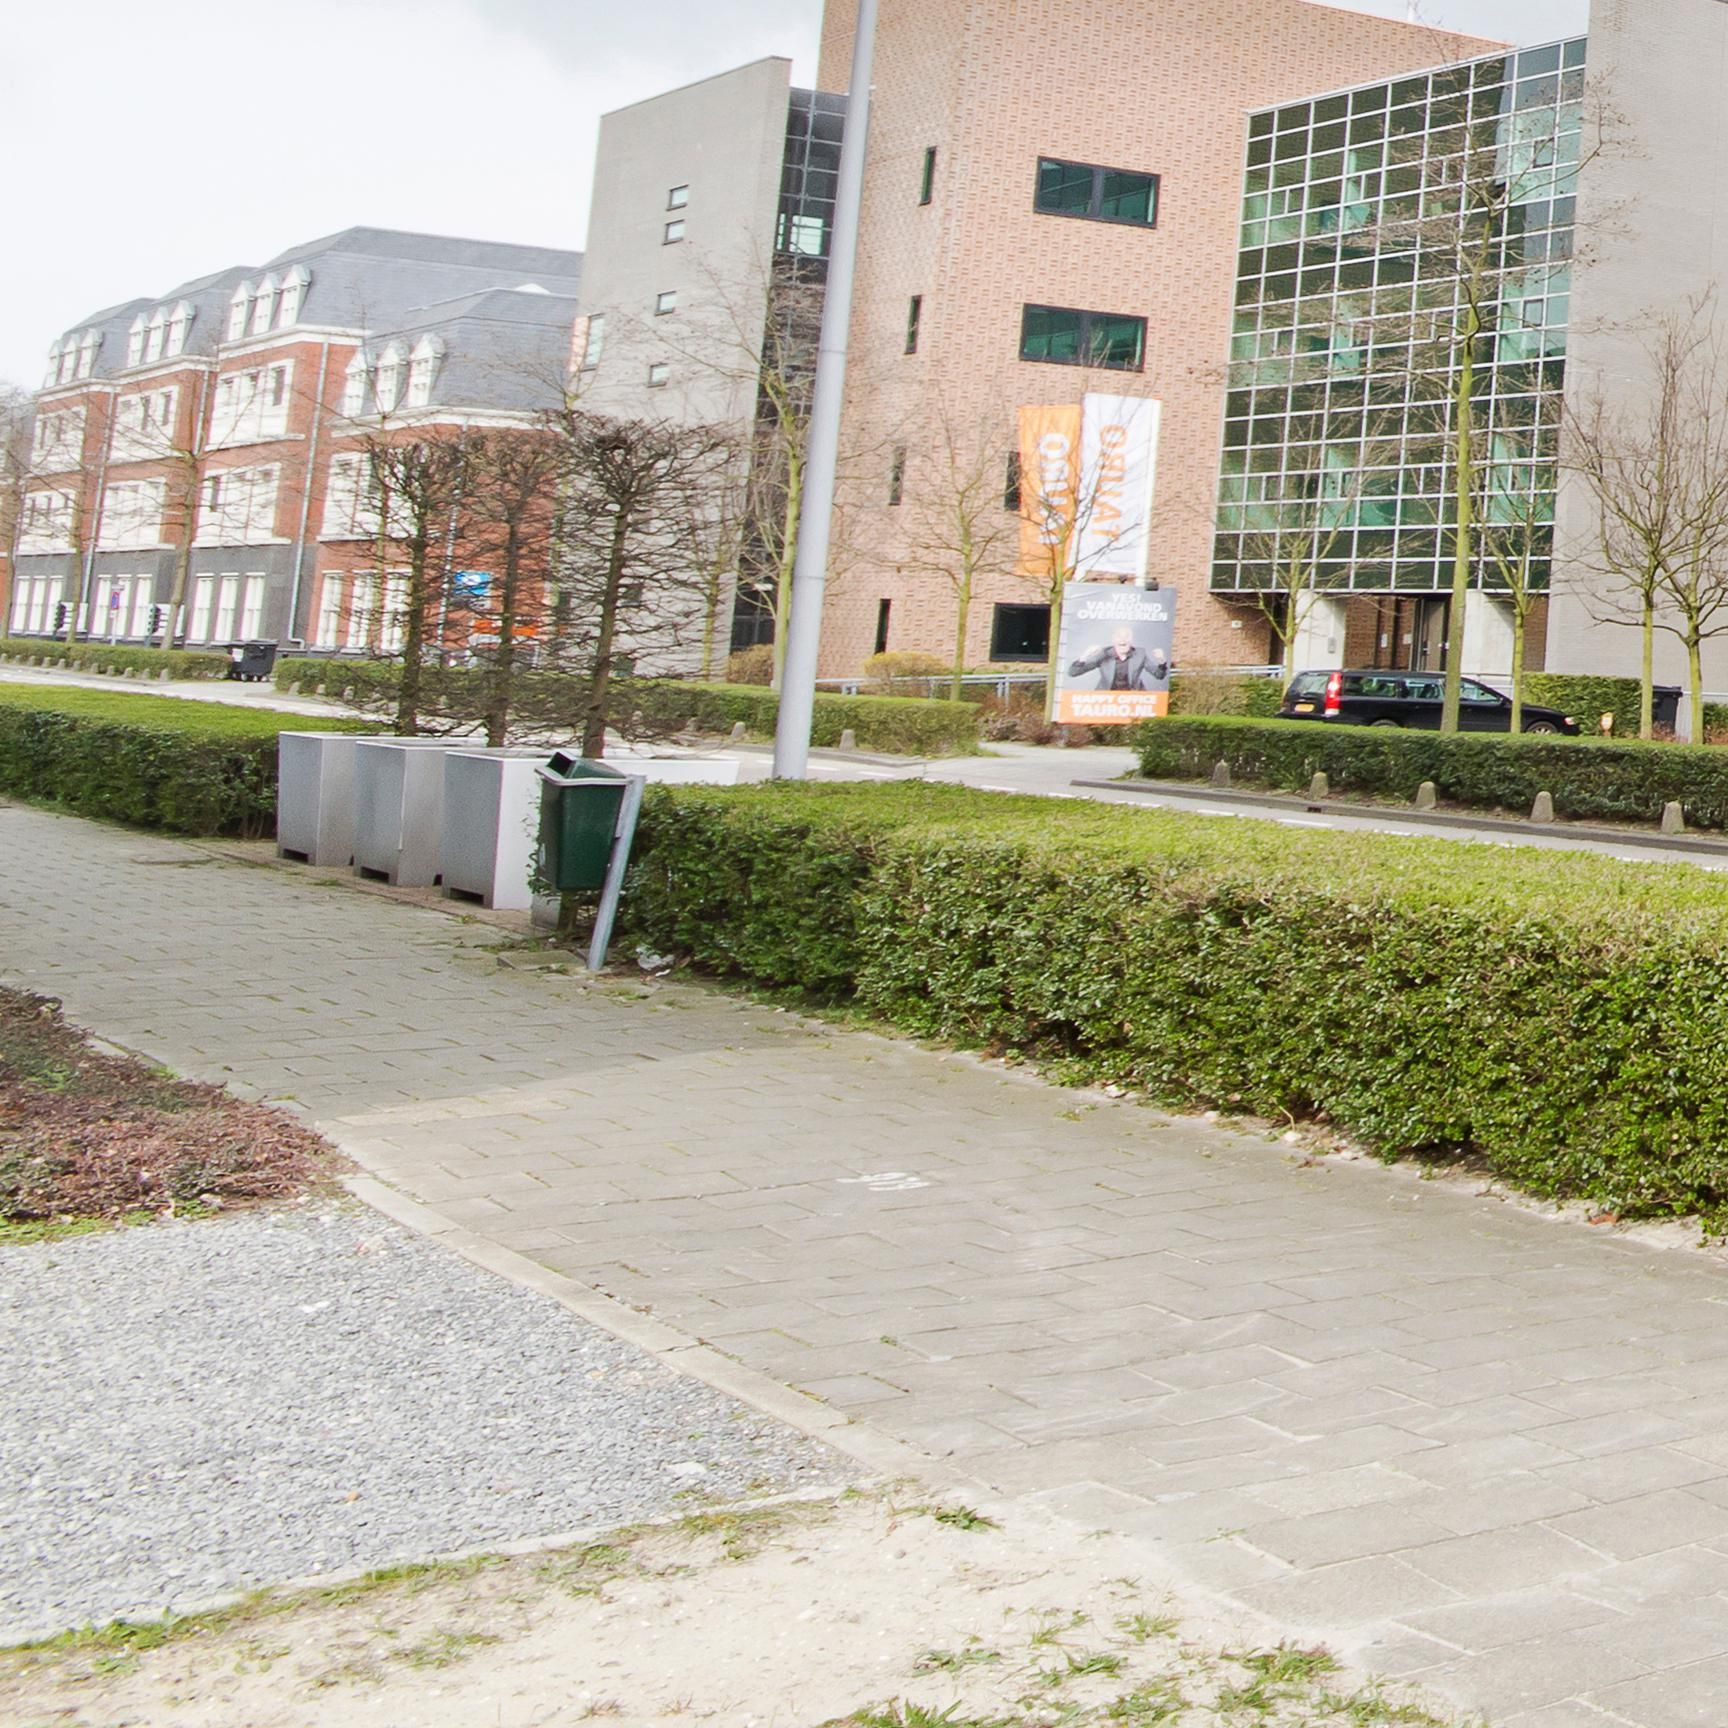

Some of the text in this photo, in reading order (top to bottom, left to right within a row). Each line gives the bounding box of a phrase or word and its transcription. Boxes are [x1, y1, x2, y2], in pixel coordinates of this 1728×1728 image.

[1085, 601, 1162, 613] VANAVOND
[1077, 610, 1168, 622] OVERWERKEN
[1072, 704, 1156, 717] TAURO.NL
